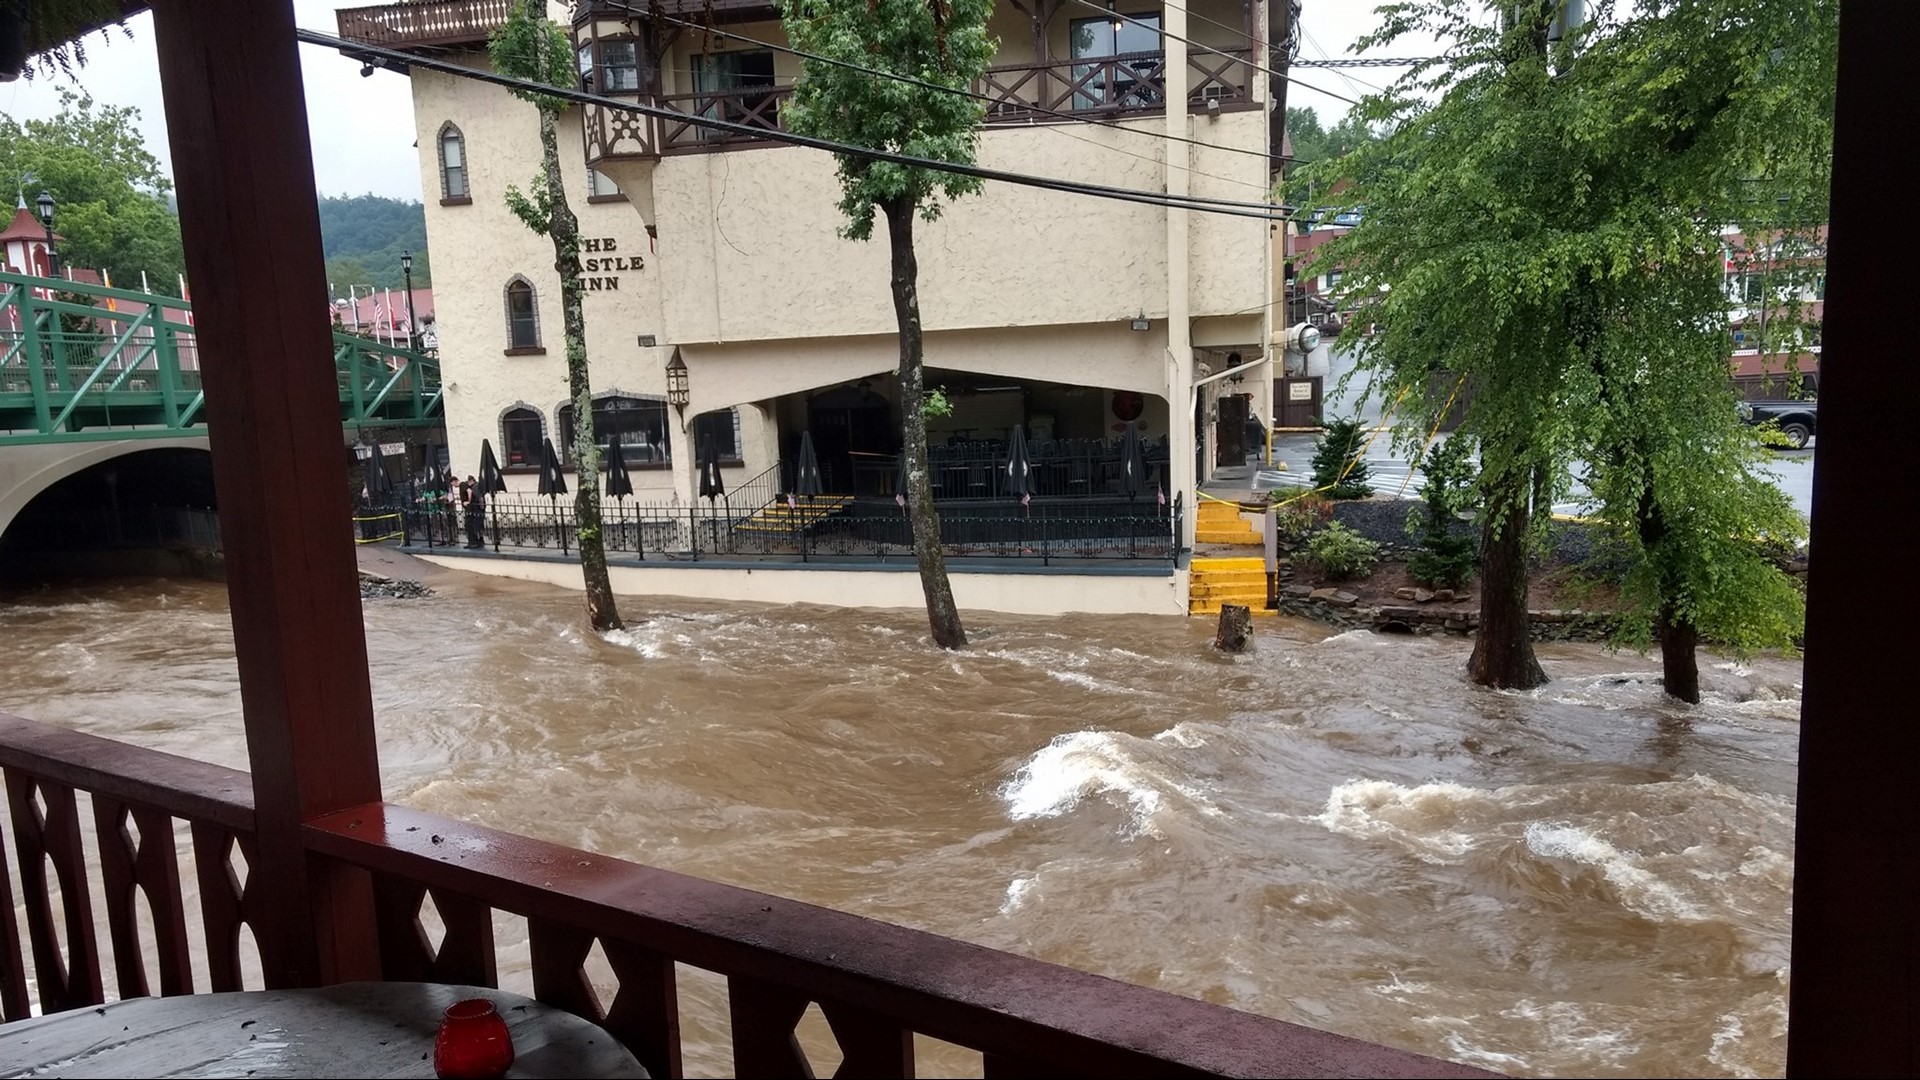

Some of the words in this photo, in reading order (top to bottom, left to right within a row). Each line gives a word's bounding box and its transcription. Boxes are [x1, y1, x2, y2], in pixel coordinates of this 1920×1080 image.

[578, 238, 617, 252] HE
[578, 256, 644, 272] STLE
[577, 276, 619, 291] INN
